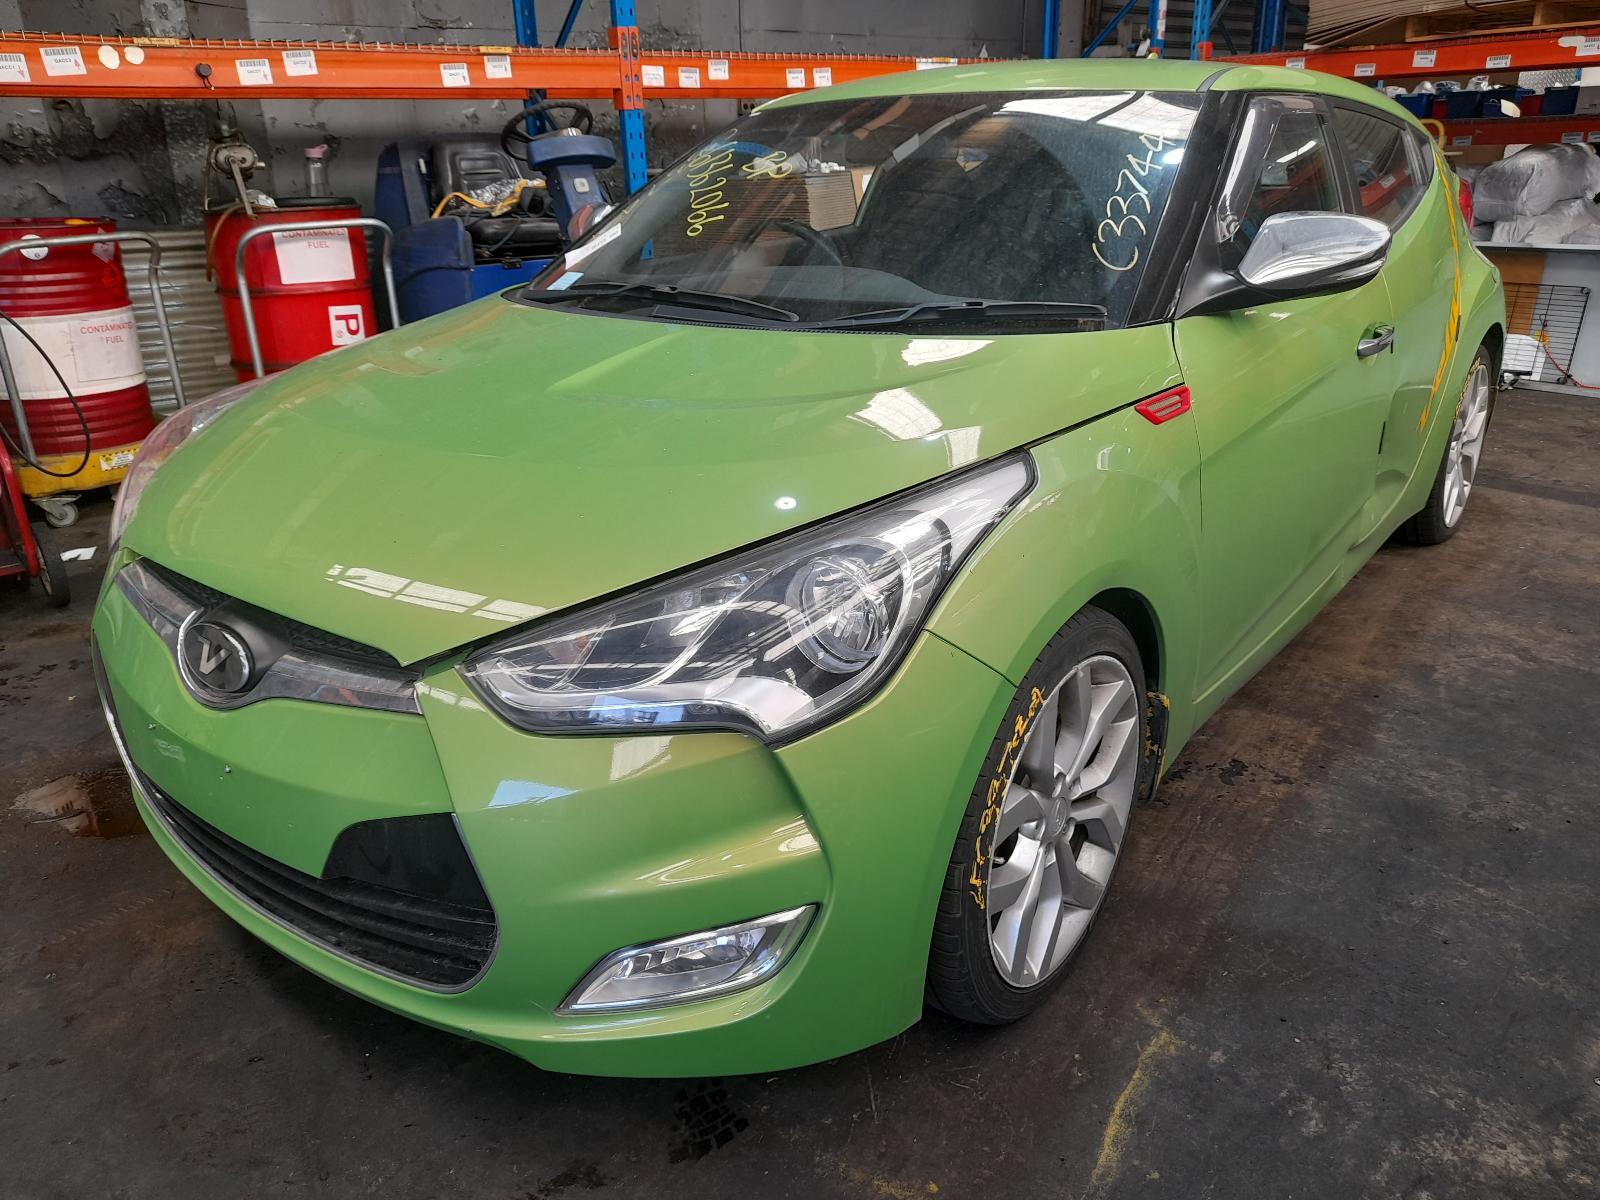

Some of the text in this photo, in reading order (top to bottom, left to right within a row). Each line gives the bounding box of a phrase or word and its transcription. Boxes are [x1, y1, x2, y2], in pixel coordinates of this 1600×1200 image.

[1092, 132, 1177, 271] C33744
[335, 314, 359, 335] P
[105, 336, 124, 344] FUEL
